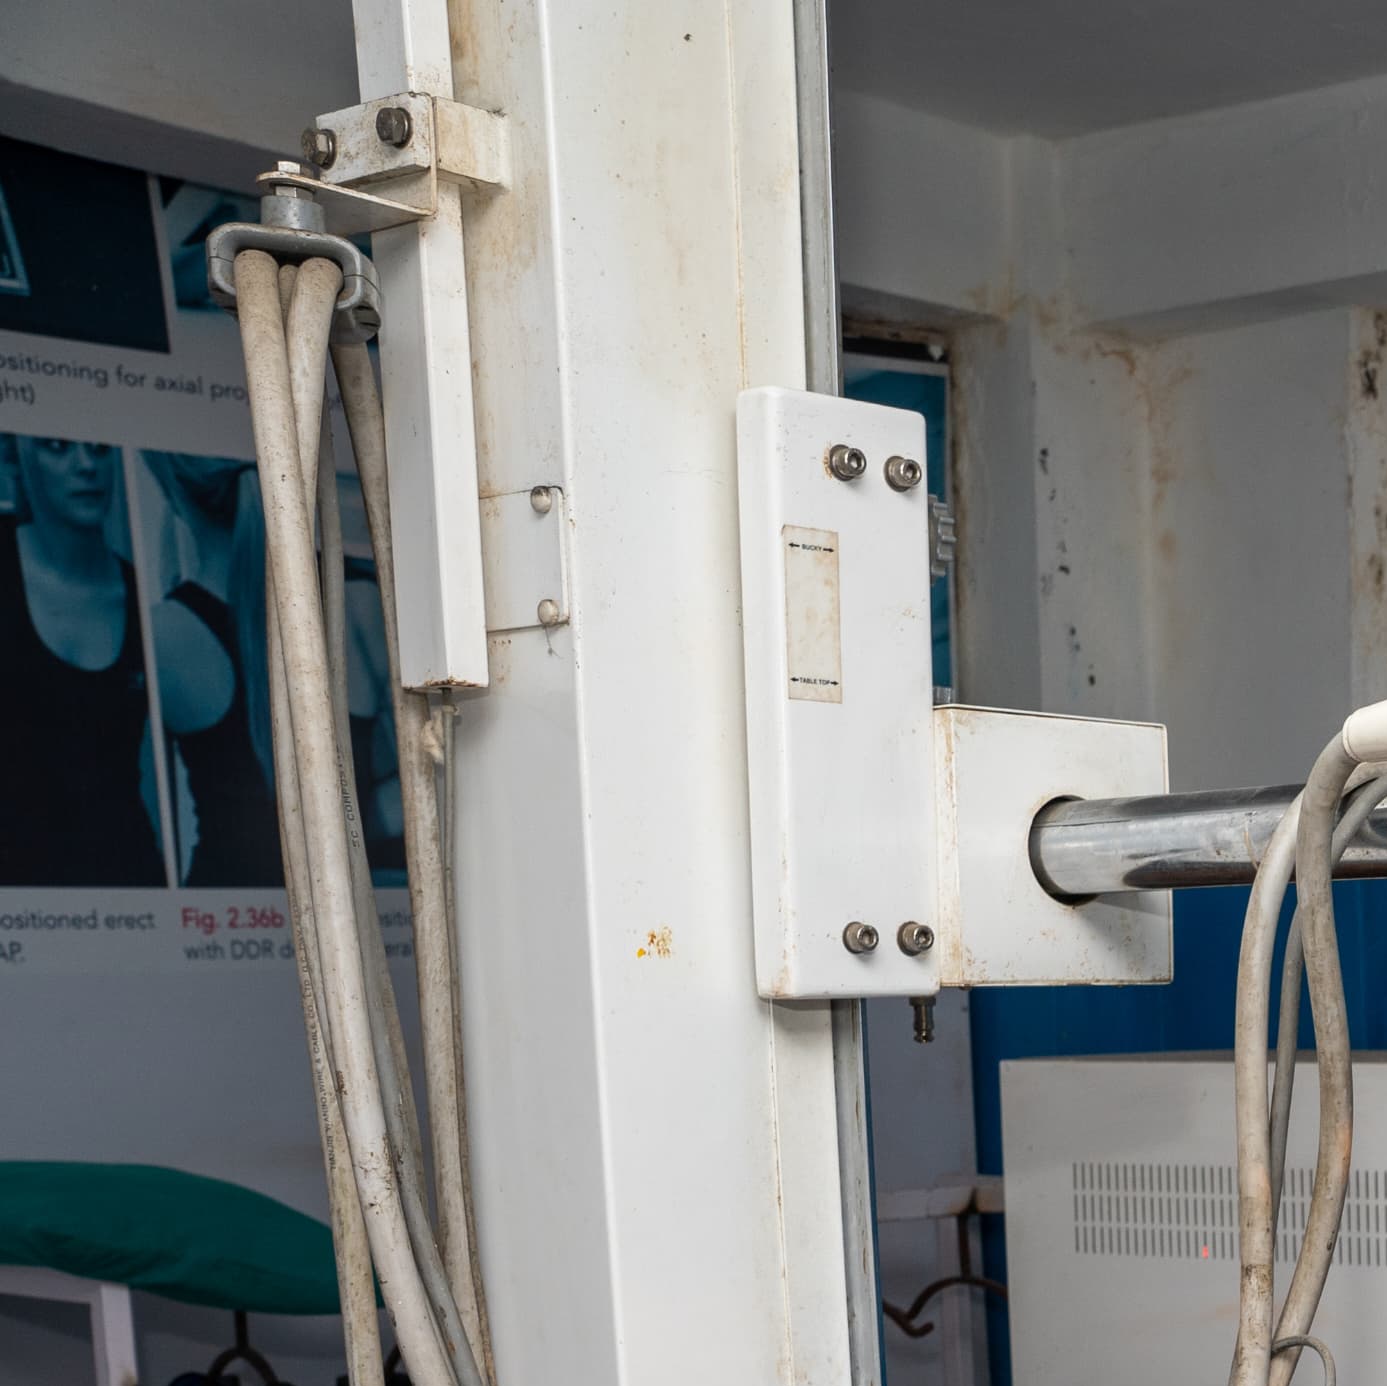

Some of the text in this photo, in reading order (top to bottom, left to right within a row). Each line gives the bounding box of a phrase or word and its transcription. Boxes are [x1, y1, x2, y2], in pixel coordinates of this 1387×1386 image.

[116, 364, 146, 389] for
[154, 375, 202, 396] axial
[210, 383, 249, 405] pro
[801, 543, 822, 552] BUCKY
[799, 676, 831, 686] TABLE TOP
[104, 911, 155, 930] erect
[181, 906, 285, 935] Fig. 2.36b
[184, 939, 226, 961] with
[231, 939, 274, 960] DDR
